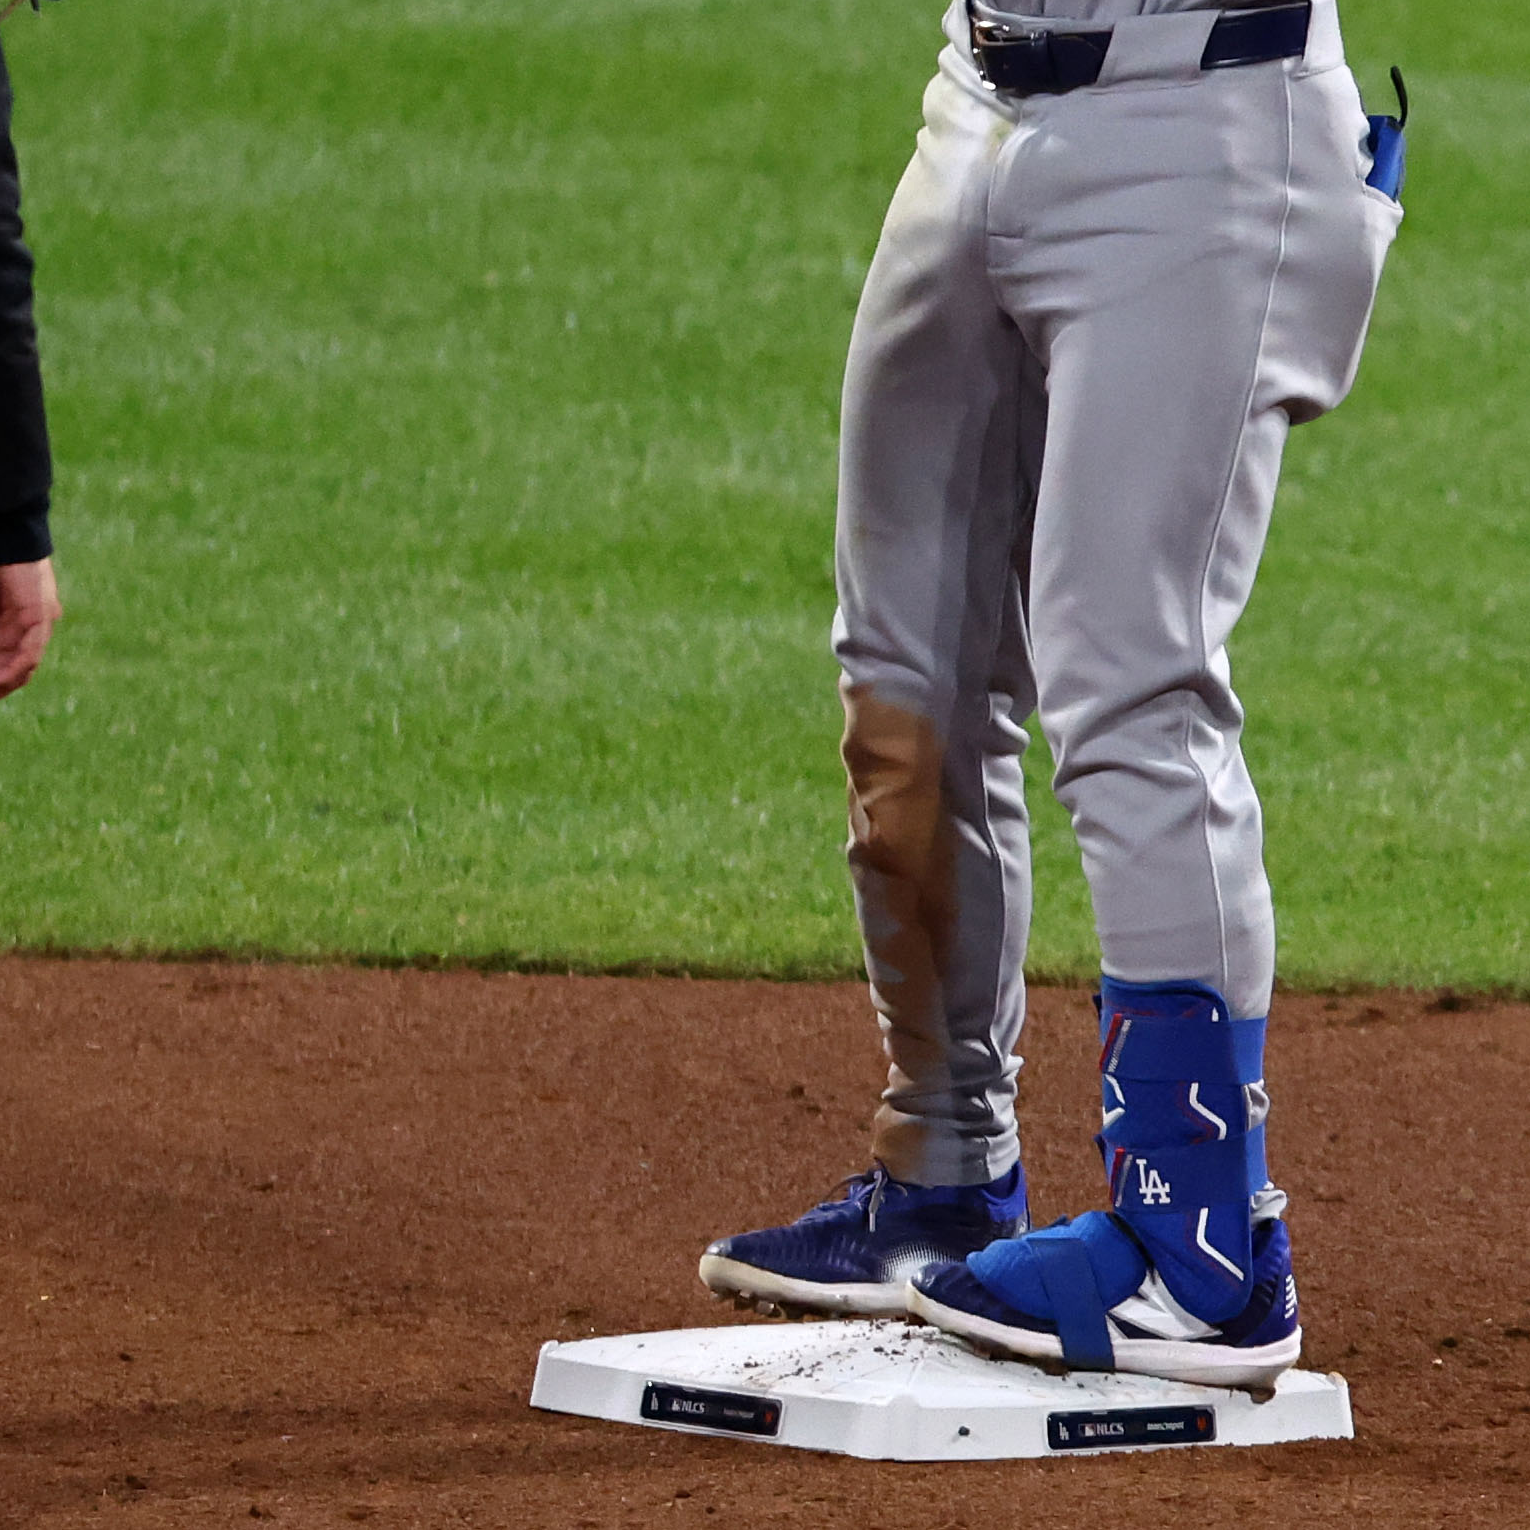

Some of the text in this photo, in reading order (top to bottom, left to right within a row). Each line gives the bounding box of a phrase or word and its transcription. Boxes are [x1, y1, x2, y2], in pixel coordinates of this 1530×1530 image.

[1135, 1158, 1171, 1205] LA
[681, 1399, 706, 1414] NLCS
[1096, 1422, 1125, 1436] NLCS
